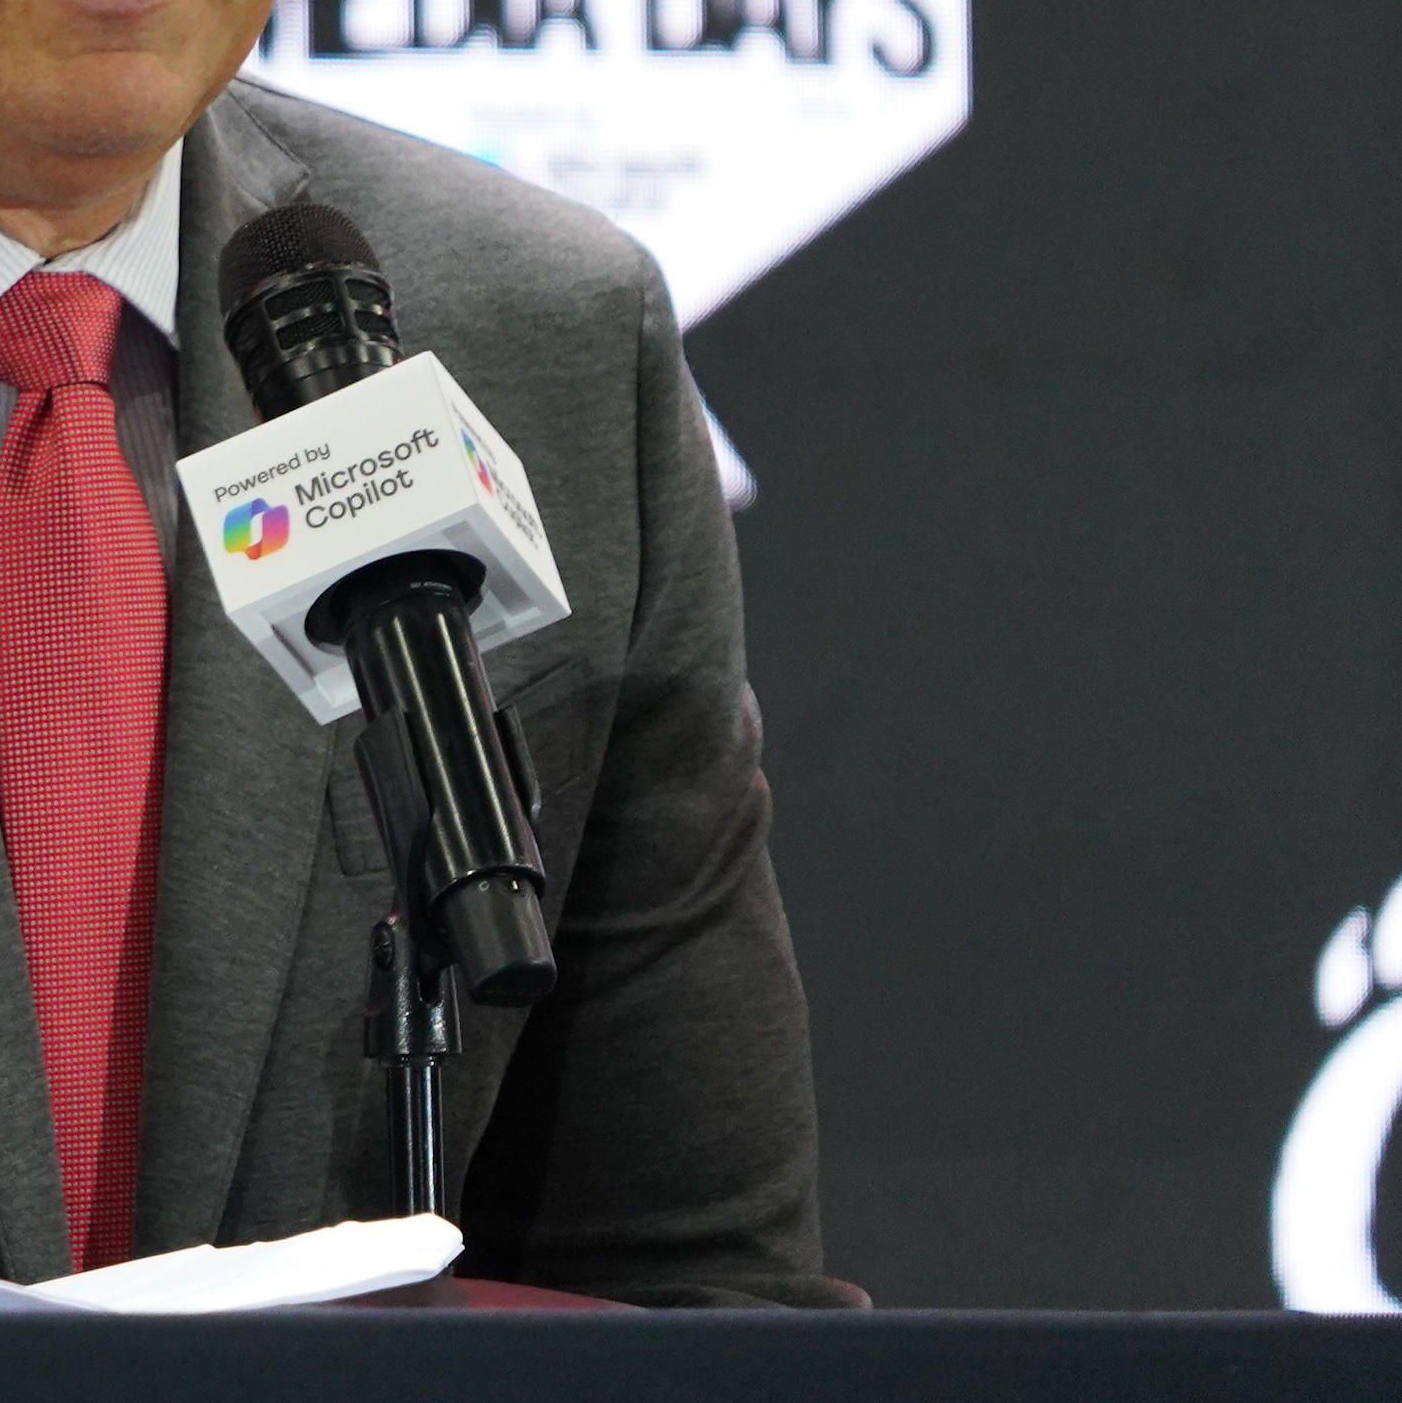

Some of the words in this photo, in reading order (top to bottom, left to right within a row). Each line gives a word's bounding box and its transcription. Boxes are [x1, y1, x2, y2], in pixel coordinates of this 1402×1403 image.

[213, 453, 302, 503] Powered
[304, 442, 332, 461] by
[294, 428, 440, 506] Microsoft
[305, 468, 414, 529] Copilot
